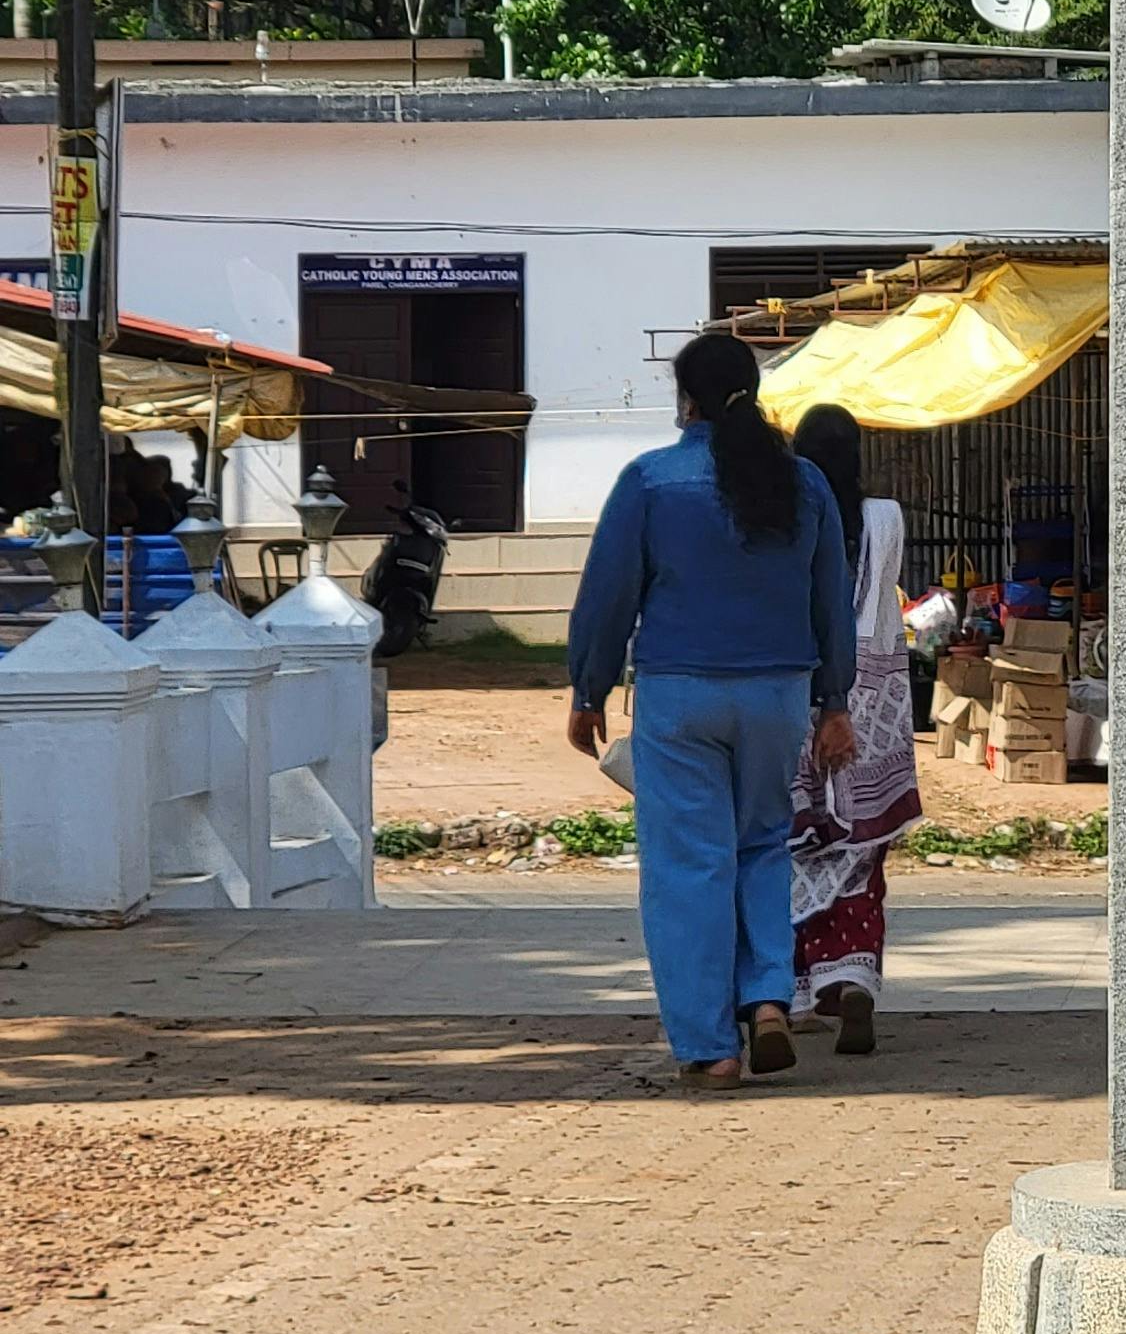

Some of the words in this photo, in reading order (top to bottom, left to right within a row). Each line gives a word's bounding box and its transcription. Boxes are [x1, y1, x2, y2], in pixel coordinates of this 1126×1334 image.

[301, 269, 360, 281] CATHOLIC
[362, 270, 403, 281] YOUNG
[405, 270, 439, 281] MENS
[441, 270, 518, 281] ASSOCIATION
